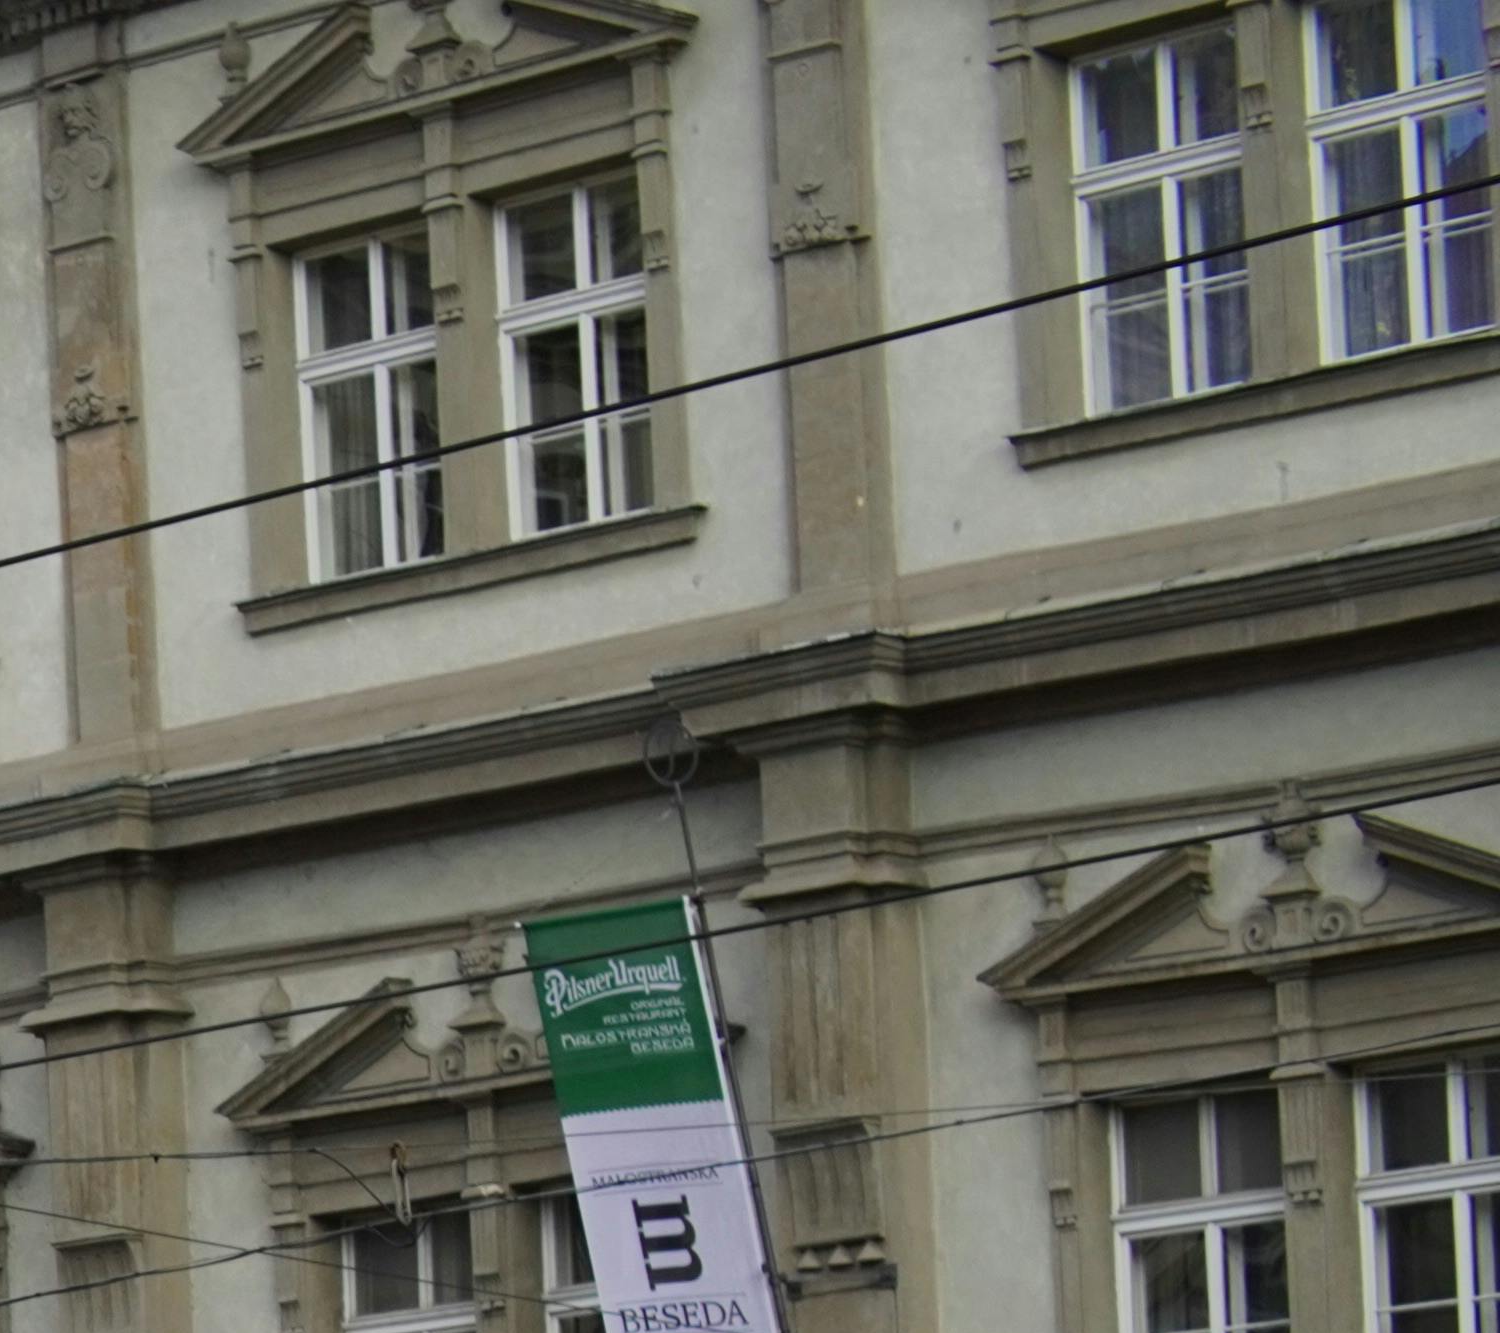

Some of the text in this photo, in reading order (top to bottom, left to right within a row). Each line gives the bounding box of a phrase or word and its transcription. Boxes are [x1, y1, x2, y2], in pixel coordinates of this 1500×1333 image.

[544, 955, 682, 1018] Pilsner Urquell
[631, 1037, 695, 1055] BESEDA
